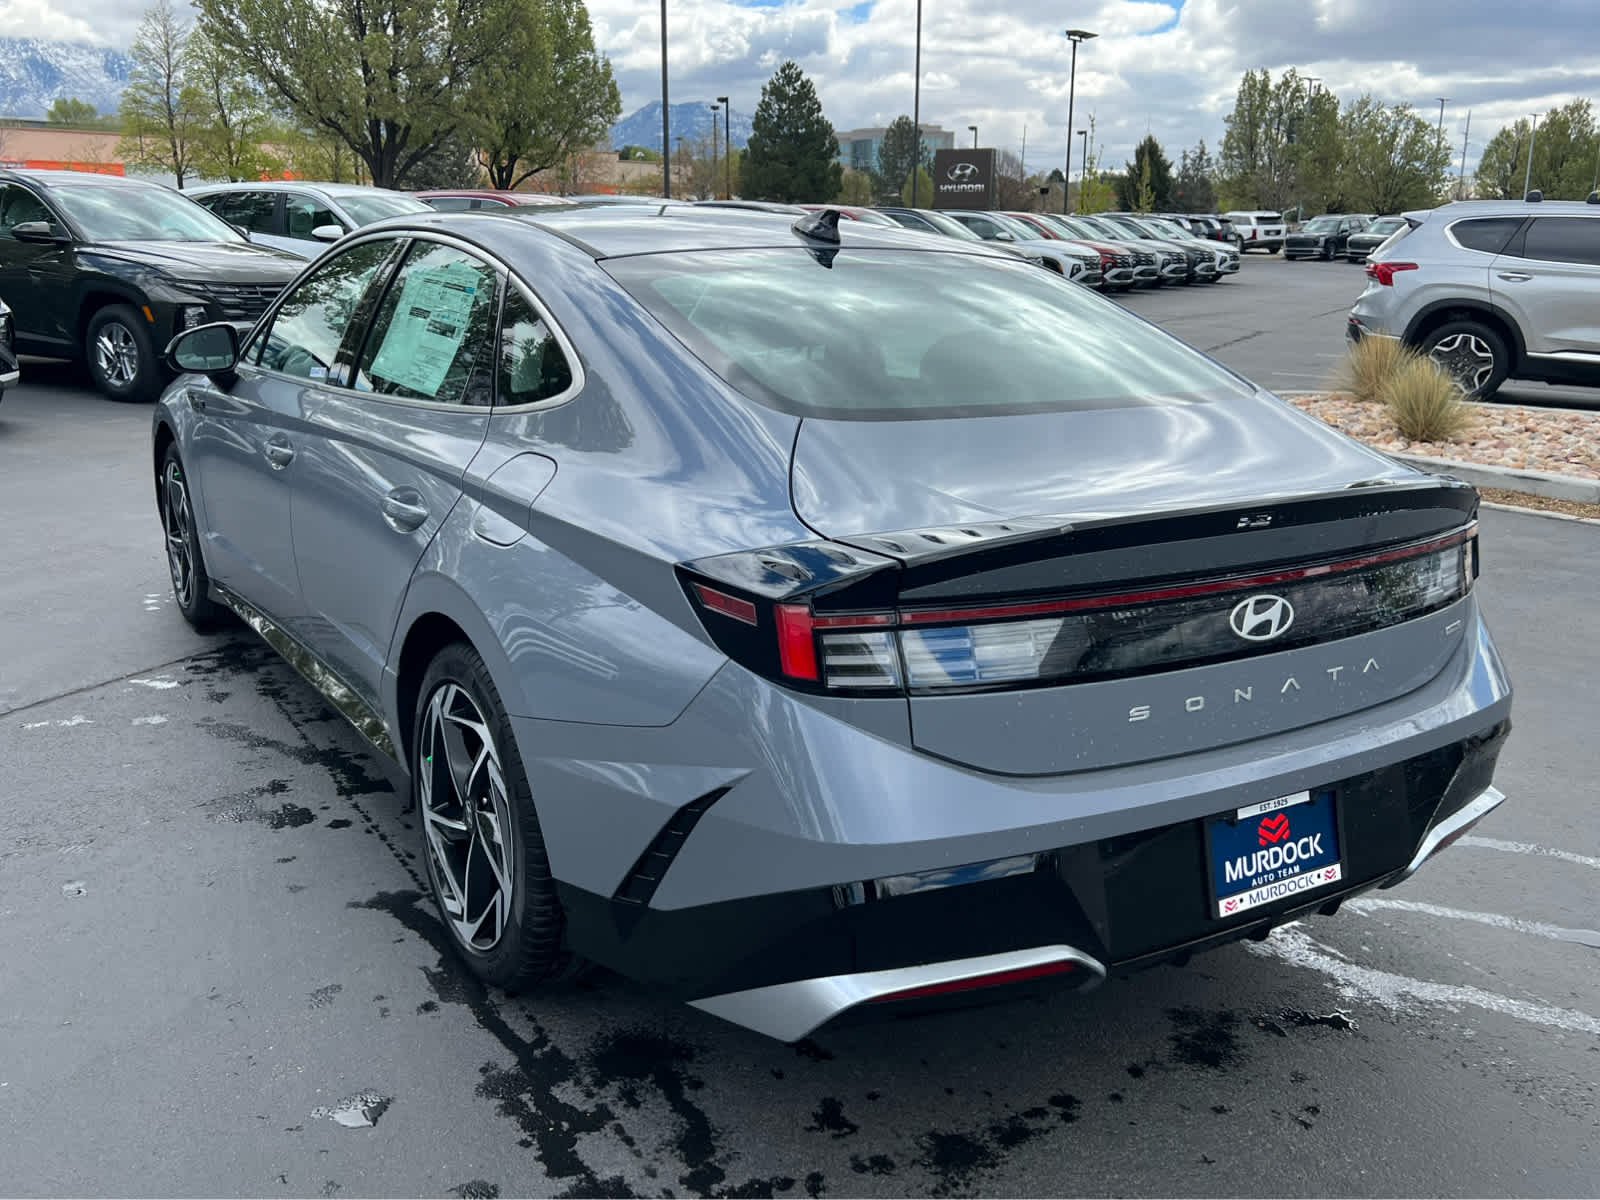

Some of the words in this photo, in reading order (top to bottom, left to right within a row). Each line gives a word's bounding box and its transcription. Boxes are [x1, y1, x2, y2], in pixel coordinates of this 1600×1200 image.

[939, 183, 985, 193] HYUNDAI
[1128, 657, 1380, 722] SONATA
[1259, 800, 1272, 812] EST.
[1224, 832, 1324, 883] MURDOCK
[1251, 873, 1275, 888] AUTO
[1277, 864, 1300, 878] TEAM
[1249, 875, 1315, 905] MURDOCK
